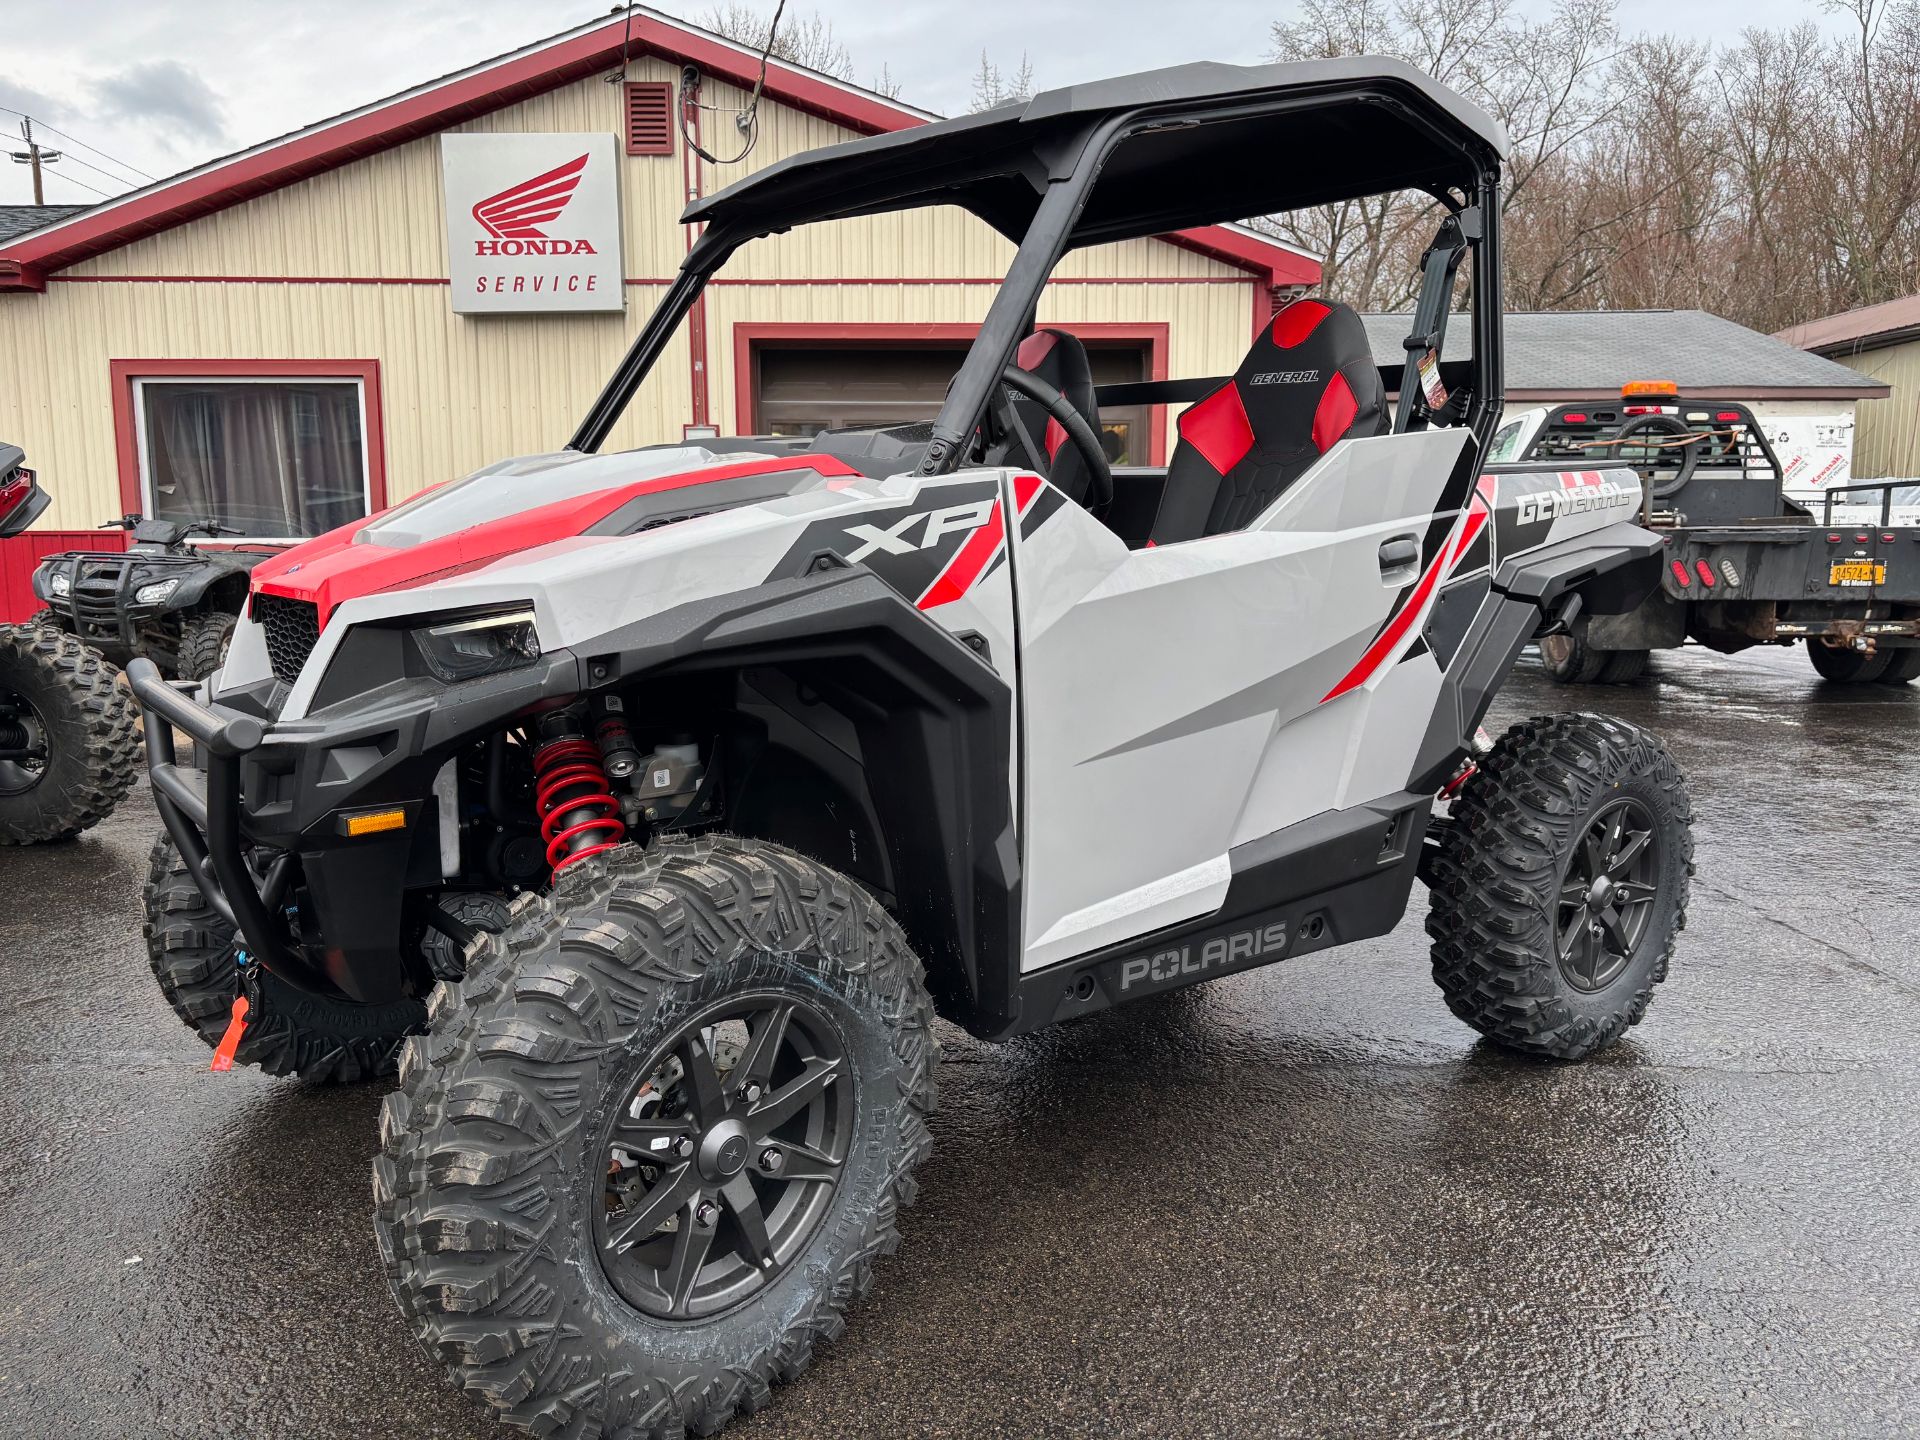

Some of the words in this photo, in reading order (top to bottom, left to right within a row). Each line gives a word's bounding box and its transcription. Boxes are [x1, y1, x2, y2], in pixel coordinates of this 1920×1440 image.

[475, 239, 598, 256] HONDA
[476, 275, 598, 293] SERVICE
[1250, 370, 1319, 386] GENERAL
[1810, 453, 1843, 485] Kawasaki
[1515, 481, 1630, 526] GENERAL
[842, 499, 995, 564] XP
[1851, 579, 1873, 587] Motors
[1121, 921, 1287, 992] POLARIS
